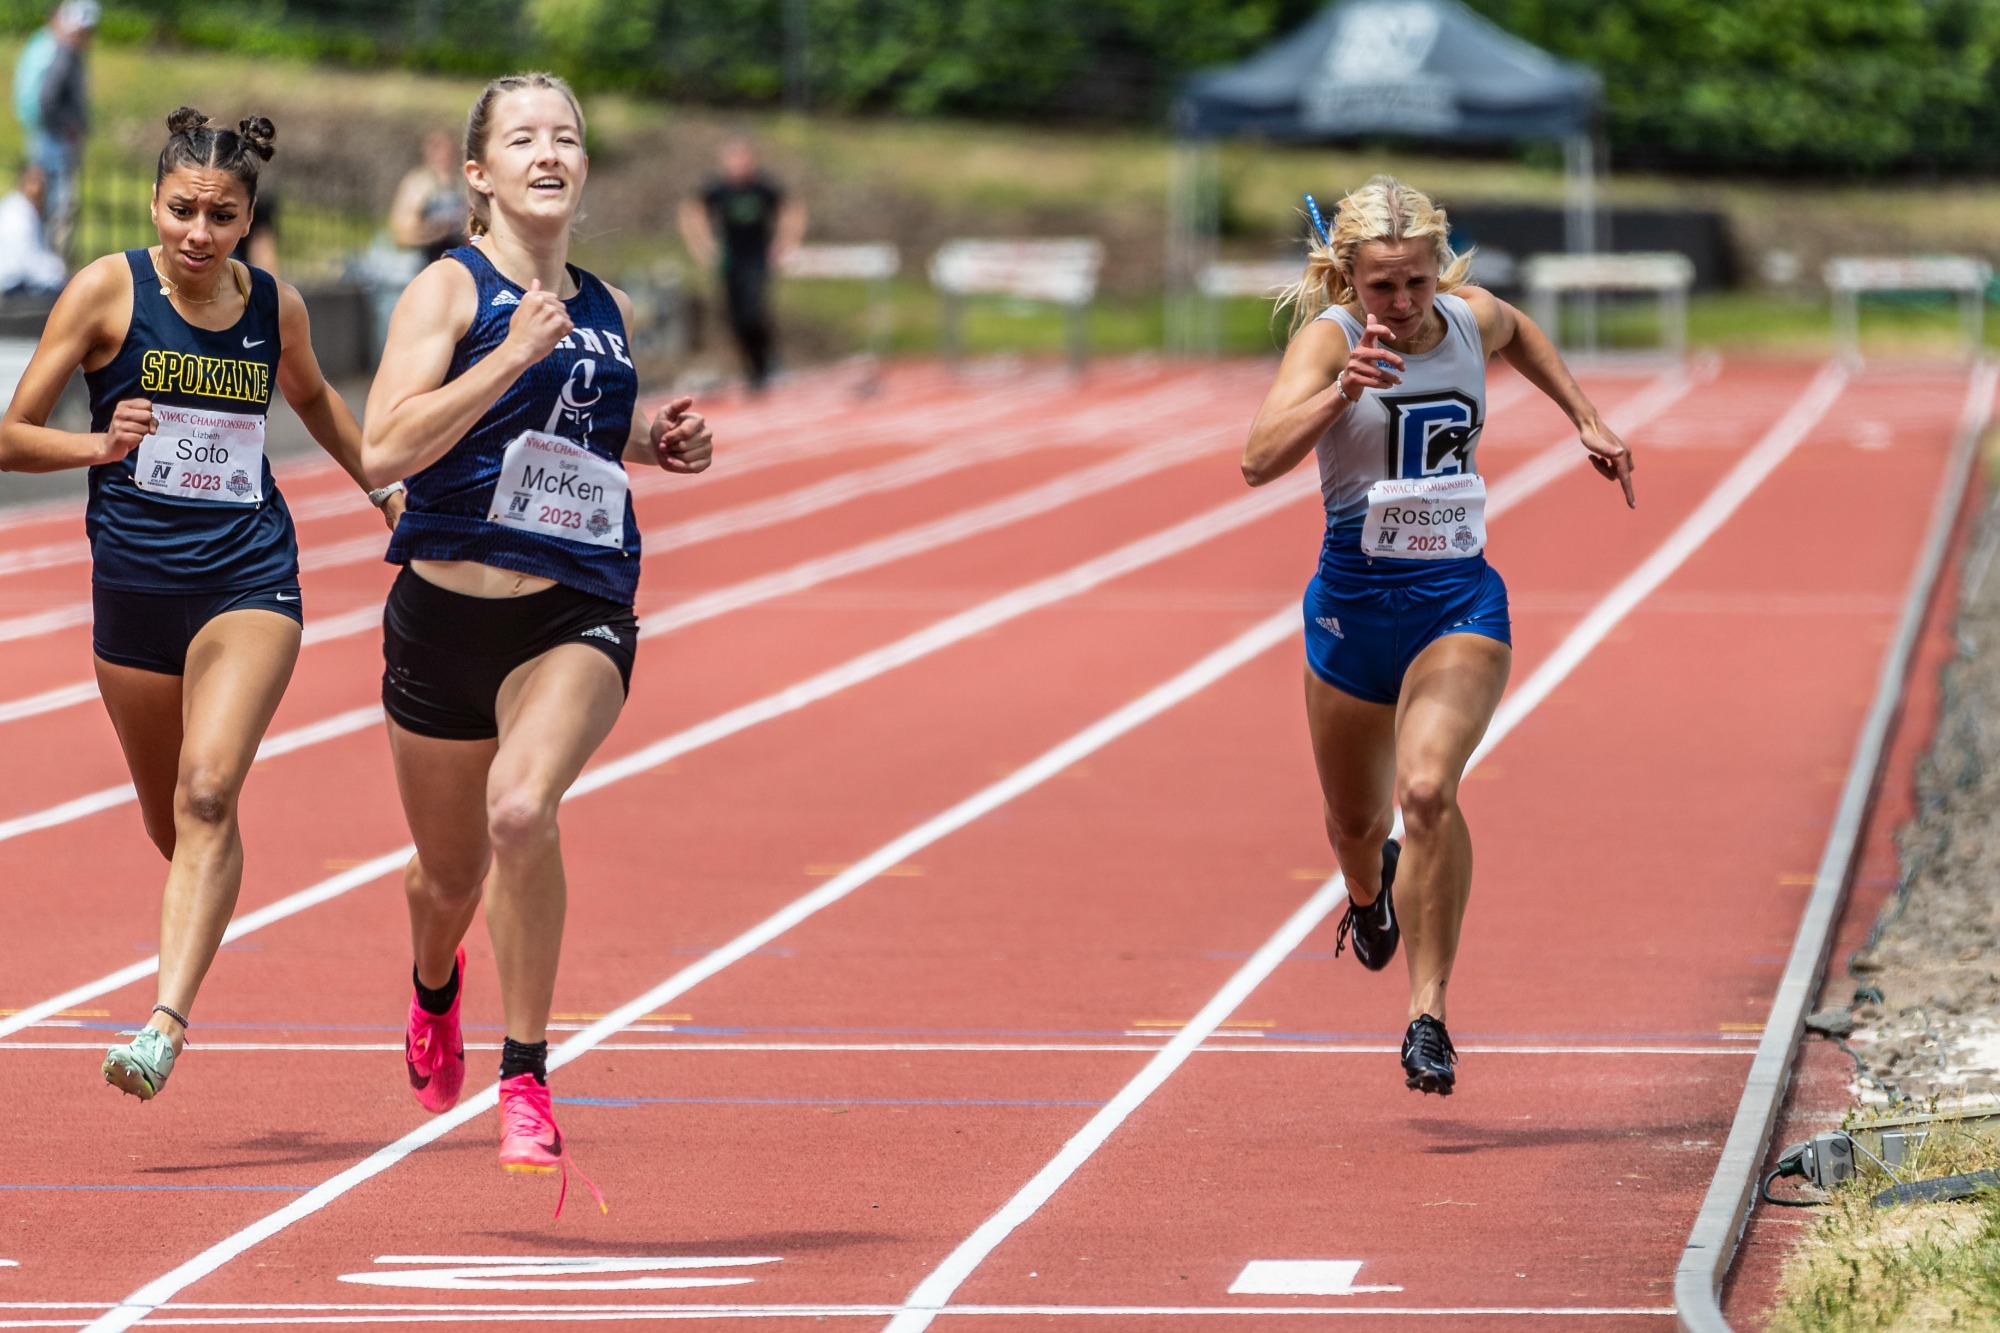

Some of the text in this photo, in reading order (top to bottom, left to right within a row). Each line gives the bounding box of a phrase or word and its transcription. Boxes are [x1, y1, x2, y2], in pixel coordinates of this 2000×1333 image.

[554, 327, 634, 370] ANE
[141, 350, 269, 404] SPOKANE
[159, 410, 256, 430] NWAC CHAMPIONSHIPS
[192, 429, 220, 440] Lizbeth
[525, 437, 553, 451] NWAC
[176, 438, 229, 464] Soto
[559, 460, 578, 471] Sara
[180, 472, 221, 491] 2023
[521, 465, 603, 503] McKen
[1382, 484, 1411, 494] NWAC
[538, 506, 582, 529] 2023
[1382, 507, 1466, 526] Roscoe
[1407, 535, 1447, 551] 2023
